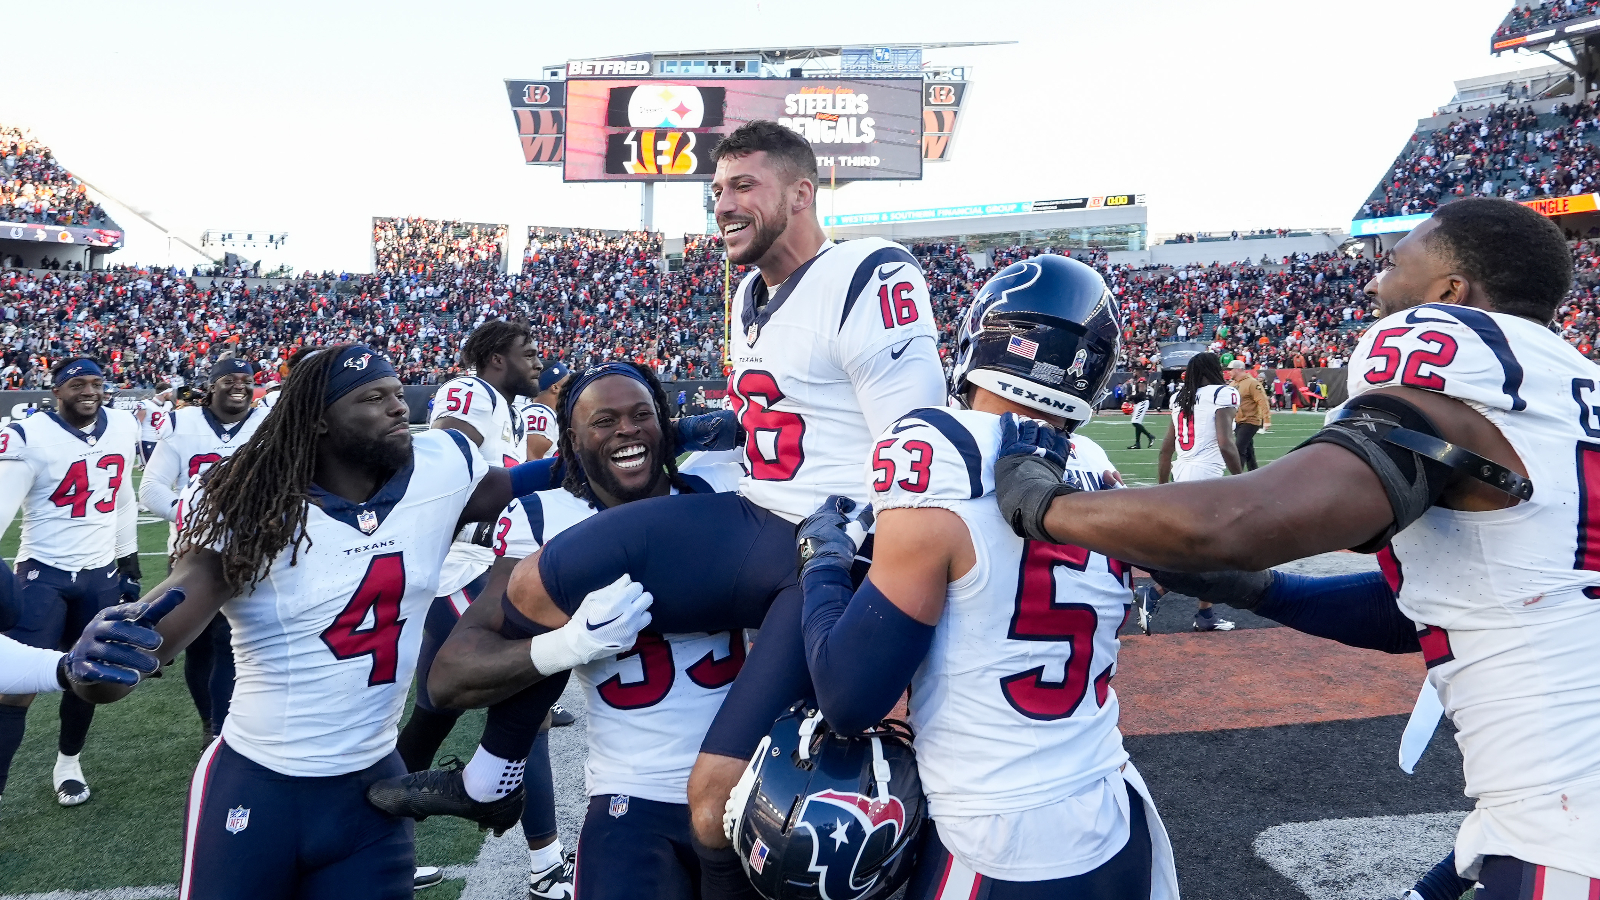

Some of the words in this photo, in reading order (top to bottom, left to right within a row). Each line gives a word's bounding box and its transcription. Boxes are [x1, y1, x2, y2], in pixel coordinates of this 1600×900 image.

[567, 61, 650, 75] BETFRED
[785, 94, 869, 115] STEELERS
[838, 155, 880, 167] THIRD
[841, 214, 880, 223] WESTERN
[890, 210, 936, 220] SOUTHERN
[937, 206, 984, 217] FINANCIAL
[985, 203, 1017, 213] GROUP
[877, 281, 919, 330] 16
[1364, 326, 1459, 391] 52
[446, 388, 473, 416] 51
[997, 380, 1076, 413] TEXANS
[527, 415, 548, 432] 20
[1177, 409, 1196, 451] 0
[872, 438, 934, 493] 53
[49, 453, 125, 519] 43
[343, 539, 395, 556] TEXANS
[319, 551, 408, 688] 4
